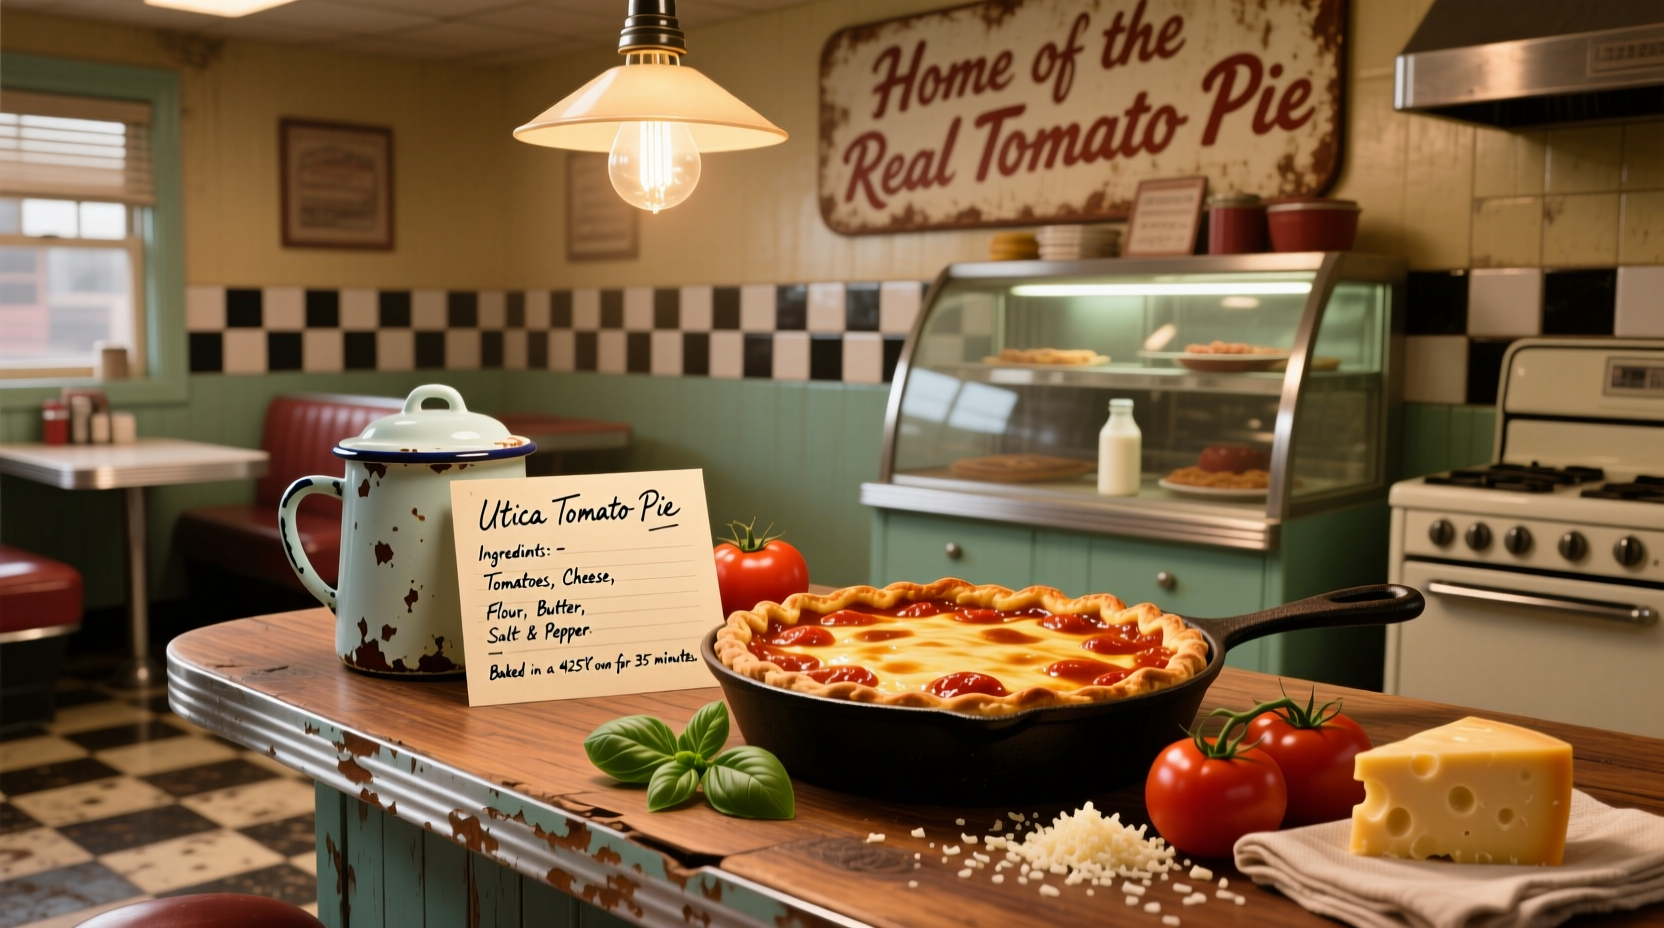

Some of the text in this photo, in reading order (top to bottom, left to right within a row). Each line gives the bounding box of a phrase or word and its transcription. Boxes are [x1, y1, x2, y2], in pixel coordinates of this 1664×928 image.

[871, 0, 1186, 120] Home of the
[843, 53, 1316, 210] Real Tomato Pie
[479, 489, 681, 532] Utica Tomato Pie
[483, 566, 615, 591] Tomatoes, Cheese,
[486, 598, 586, 621] Flour, Butter,
[486, 625, 521, 644] Salt
[526, 624, 538, 641] &
[489, 661, 526, 681] Baked
[530, 663, 542, 676] in
[546, 665, 555, 674] a
[634, 653, 653, 668] 35
